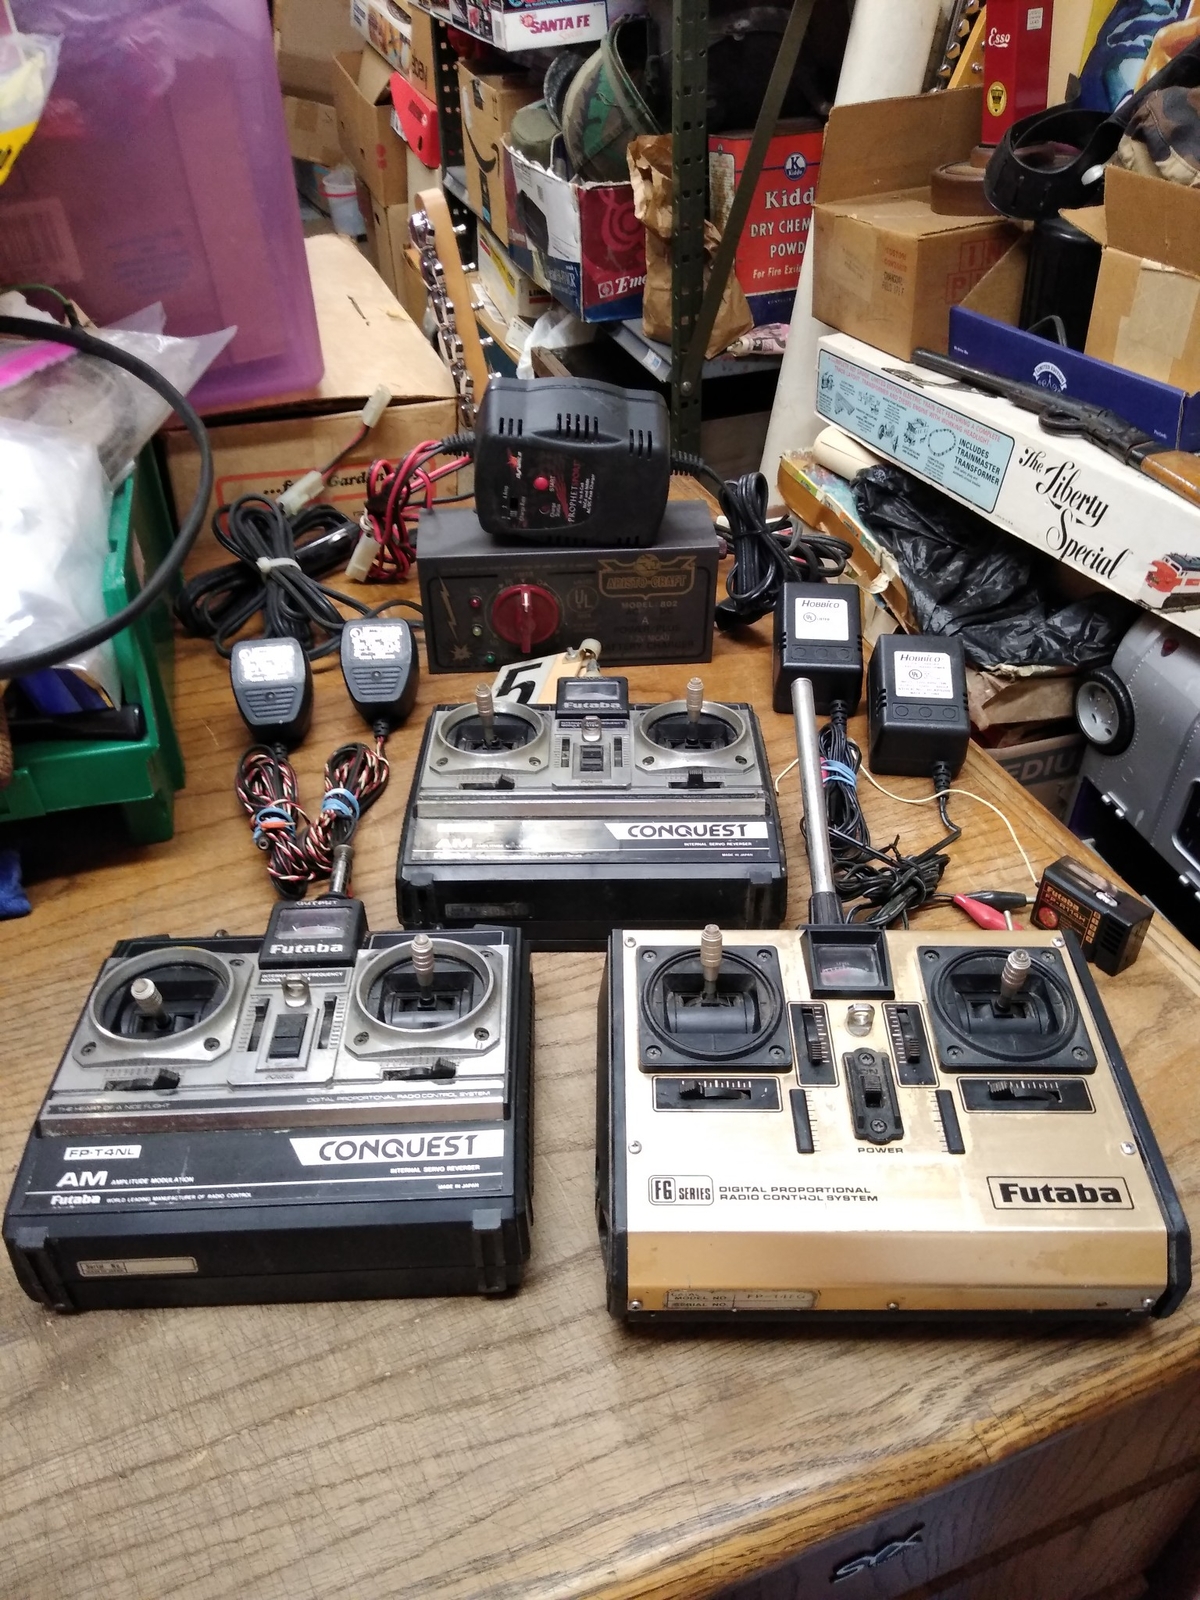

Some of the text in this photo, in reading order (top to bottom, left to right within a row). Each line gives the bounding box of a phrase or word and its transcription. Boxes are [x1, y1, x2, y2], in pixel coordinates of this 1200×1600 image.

[530, 14, 590, 34] SANTA FE
[988, 28, 1011, 48] Esso
[791, 157, 800, 170] K
[750, 217, 811, 238] DRY CHEM
[753, 269, 766, 279] For
[768, 265, 782, 277] Fire
[936, 406, 944, 415] SET
[944, 410, 970, 428] FEATURING
[975, 425, 1001, 442] COMPLETE
[940, 416, 962, 432] WORKING
[958, 438, 989, 459] INCLUDES
[957, 447, 1001, 475] TRAINMASTER
[1018, 446, 1047, 473] The
[954, 456, 1000, 486] TRANSFORMER
[1036, 460, 1109, 527] Liberty
[1046, 508, 1133, 579] Special
[660, 600, 678, 608] 802
[495, 661, 543, 704] 5
[627, 824, 748, 838] CONQUEST
[435, 838, 473, 848] AM
[269, 943, 343, 955] Futaba
[74, 1104, 103, 1112] HEART
[69, 1147, 135, 1158] FP-T4NL
[319, 1134, 478, 1161] CONQUEST
[447, 1164, 480, 1172] REVERSER
[56, 1170, 194, 1188] AM AMPLITUDE MODULATION
[50, 1194, 101, 1206] Futaba
[655, 1180, 711, 1200] FG SERIES
[999, 1183, 1123, 1203] Futaba
